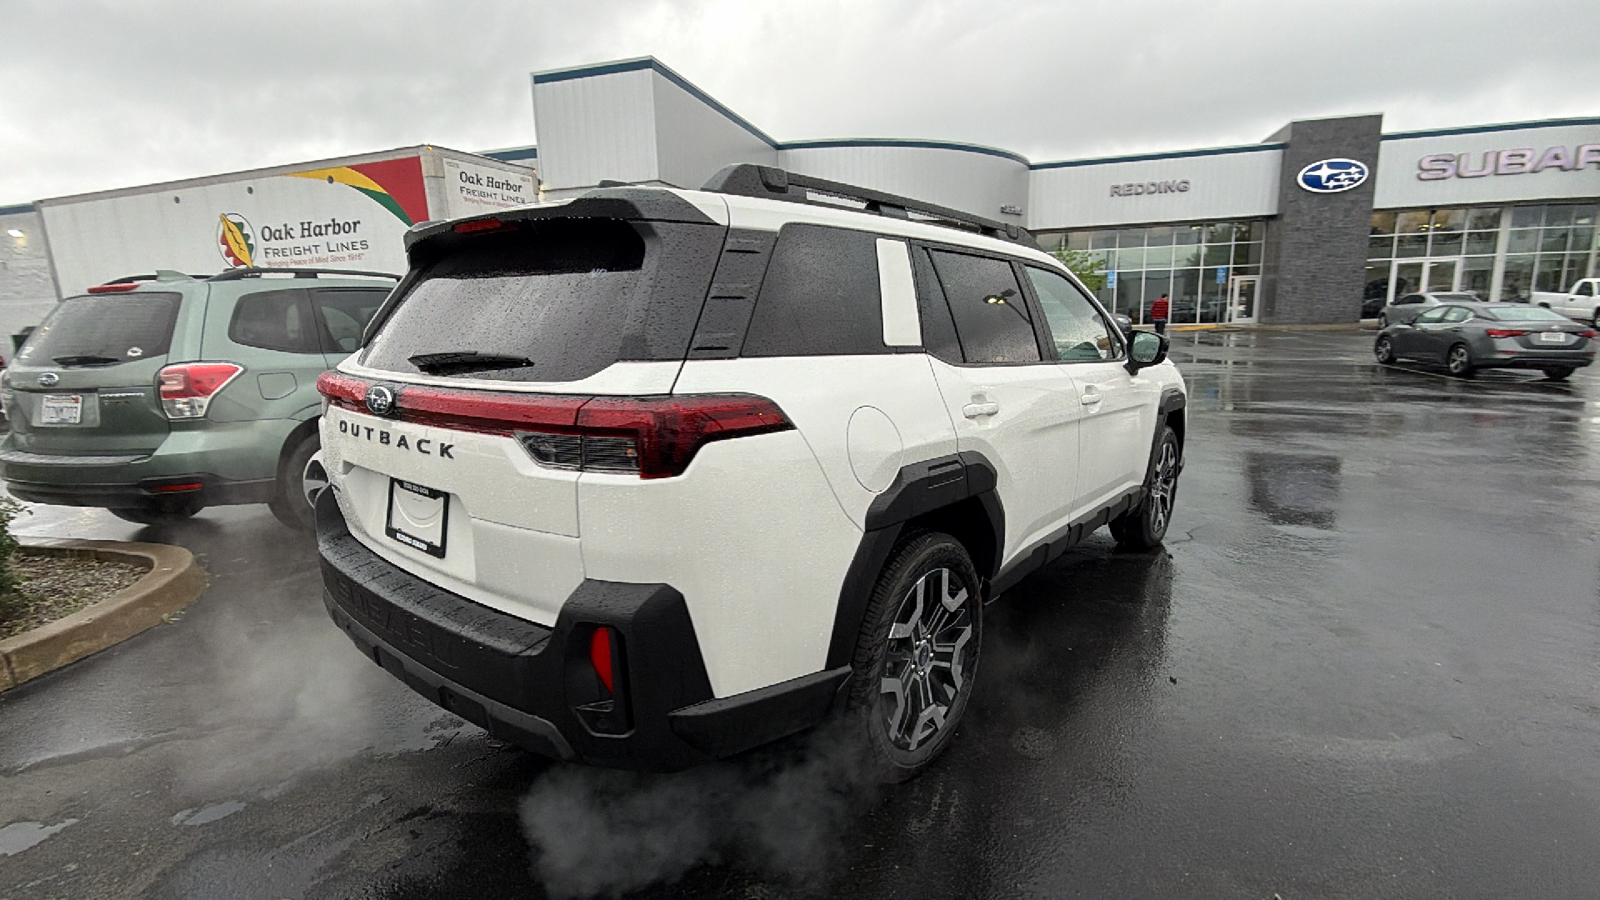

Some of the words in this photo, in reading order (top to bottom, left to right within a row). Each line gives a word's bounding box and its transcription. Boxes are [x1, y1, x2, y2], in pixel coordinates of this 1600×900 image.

[459, 171, 483, 189] Oak
[487, 177, 523, 196] Harbor
[1110, 179, 1190, 197] REDDING
[460, 187, 497, 200] FREIGHT
[501, 193, 526, 204] LINES
[261, 223, 295, 242] Oak
[300, 218, 360, 239] Harbor
[264, 245, 321, 259] FREIGHT
[326, 240, 369, 253] LINES
[339, 419, 456, 460] OUTBACK
